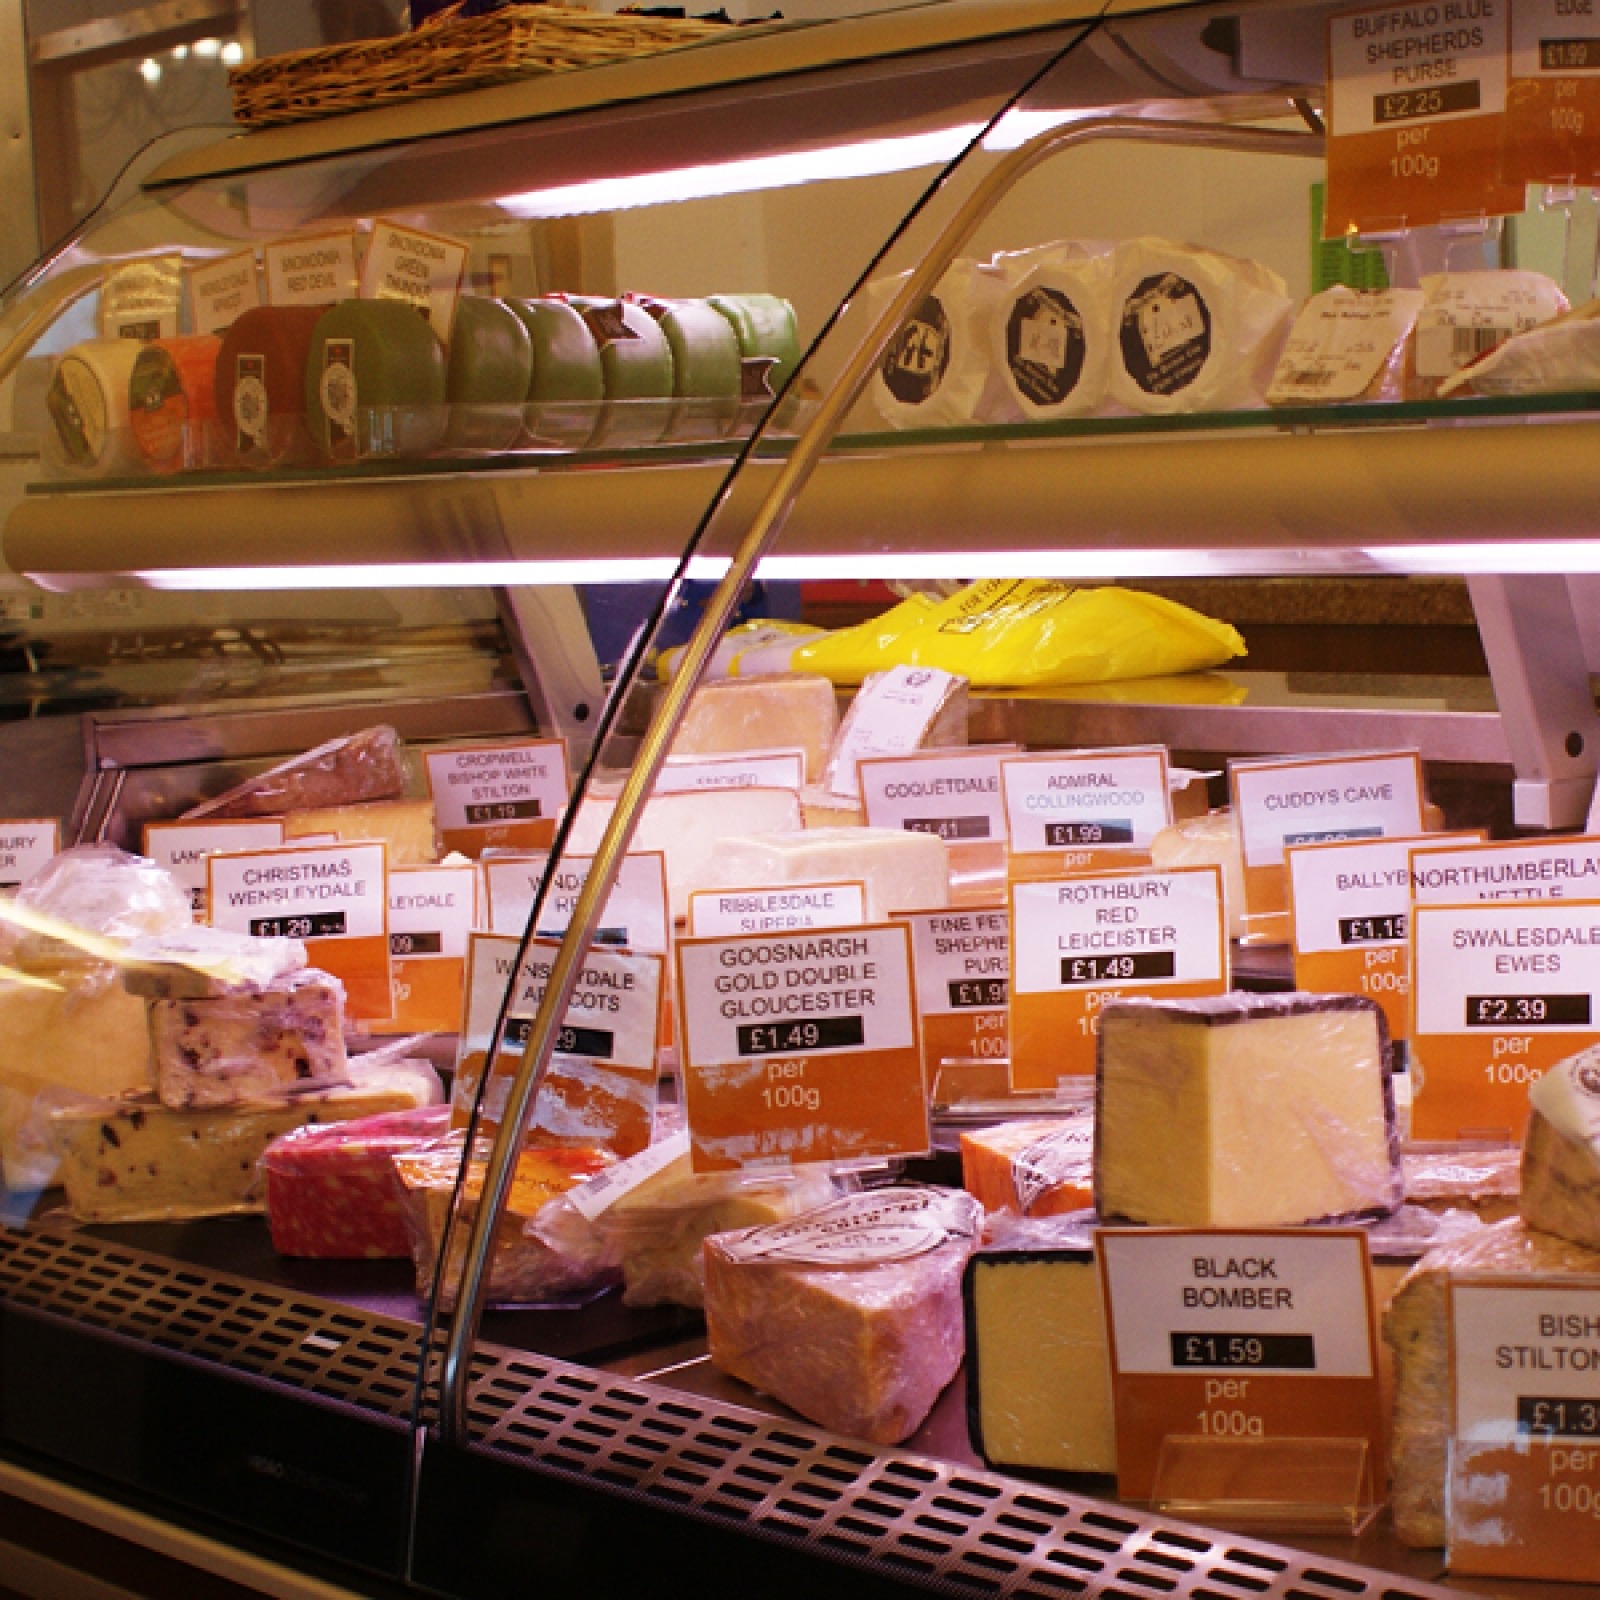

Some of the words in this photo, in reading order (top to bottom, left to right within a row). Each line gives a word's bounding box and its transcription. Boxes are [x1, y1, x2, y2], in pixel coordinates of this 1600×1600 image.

[1353, 7, 1439, 38] BUFFALO
[1444, 0, 1494, 24] BLUE
[1367, 27, 1484, 64] SHEPHERDS
[1393, 57, 1457, 85] PURSE
[1383, 90, 1444, 118] £2.25
[1397, 128, 1430, 152] per
[1390, 154, 1440, 178] 100g
[456, 751, 534, 768] CROPWELL
[447, 770, 501, 786] BISHOP
[503, 765, 548, 779] WHITE
[1047, 772, 1118, 790] ADMIRAL
[471, 784, 532, 800] STILTON
[884, 776, 998, 800] COQUETDALE
[1263, 789, 1340, 811] CUDDYS
[1343, 784, 1393, 803] CAVE
[1025, 790, 1145, 811] COLLINGWOOD
[242, 858, 352, 886] CHRISTMAS
[1064, 853, 1094, 869] per
[228, 879, 366, 907] WENSLEYDALE
[718, 891, 834, 914] RIBBLESDALE
[1058, 880, 1172, 904] ROTHBURY
[928, 916, 972, 933] FINE
[1095, 906, 1139, 924] RED
[1452, 927, 1600, 949] SWALESDALE
[719, 938, 869, 967] GOOSNARGH
[1364, 949, 1398, 968] per
[1495, 954, 1561, 973] EWES
[714, 970, 780, 993] GOLD
[785, 962, 877, 987] DOUBLE
[719, 988, 876, 1019] GLOUCESTER
[959, 983, 1008, 1004] £1.9
[1478, 999, 1547, 1022] £2.39
[975, 1015, 1004, 1032] per
[751, 1023, 820, 1051] £1.49
[1493, 1037, 1534, 1059] per
[767, 1058, 808, 1083] per
[762, 1085, 820, 1110] 100g
[1192, 1257, 1278, 1280] BLACK
[1182, 1287, 1294, 1310] BOMBER
[1185, 1336, 1265, 1364] £1.59
[1204, 1378, 1251, 1405] per
[1197, 1410, 1265, 1438] 100g
[1551, 1449, 1598, 1477] per
